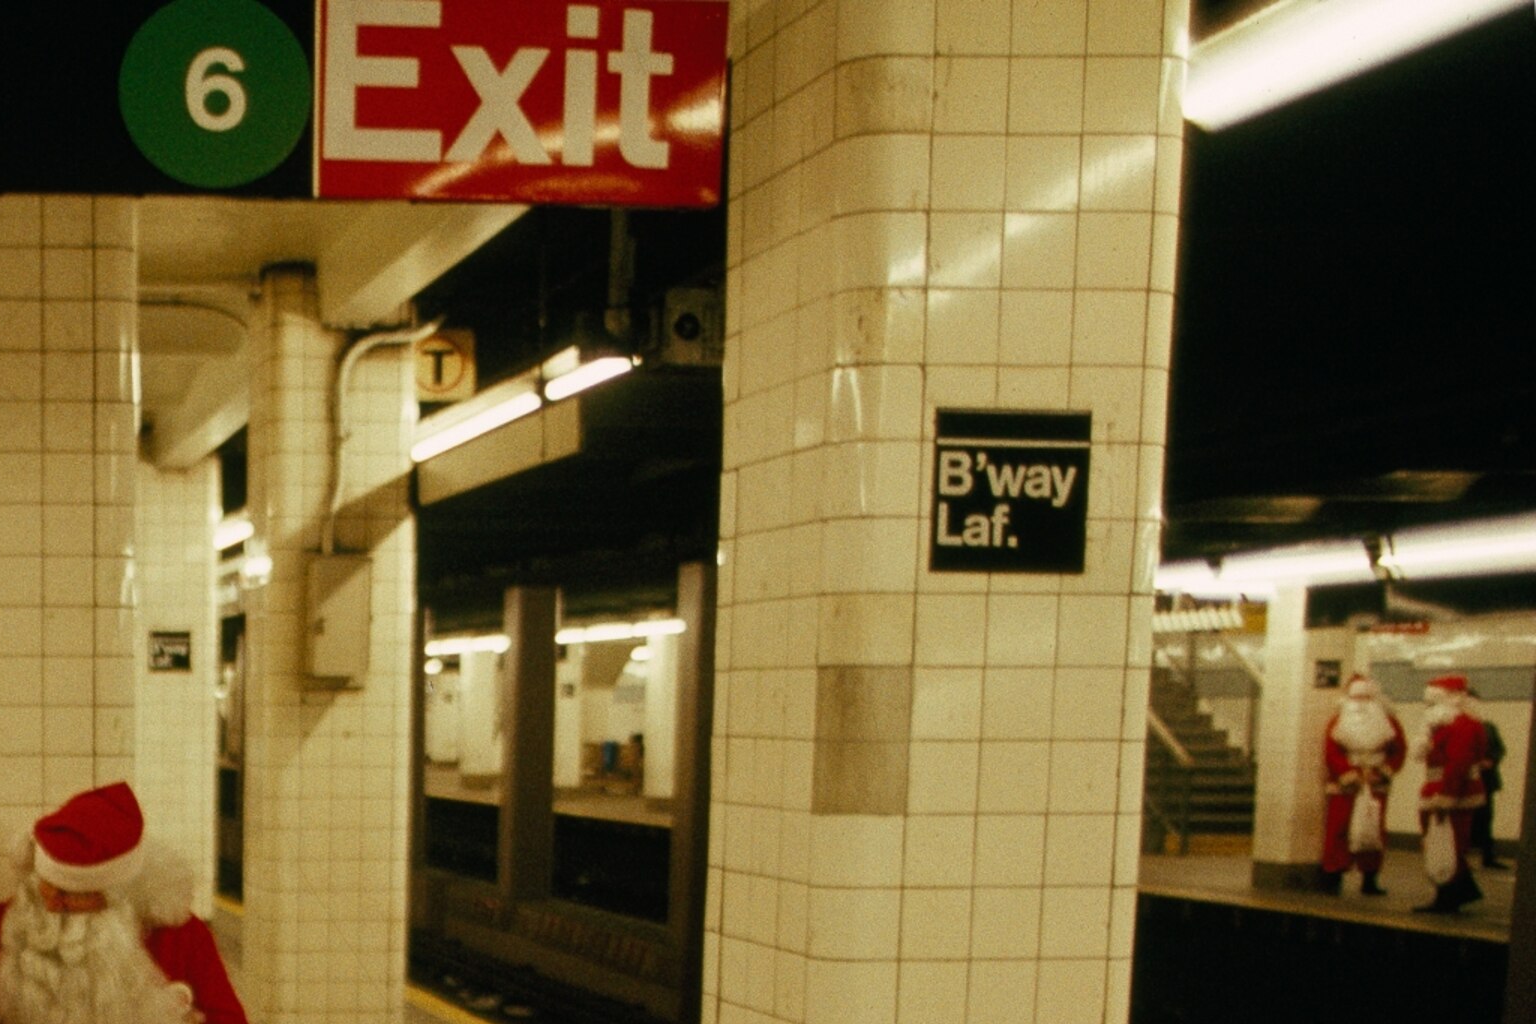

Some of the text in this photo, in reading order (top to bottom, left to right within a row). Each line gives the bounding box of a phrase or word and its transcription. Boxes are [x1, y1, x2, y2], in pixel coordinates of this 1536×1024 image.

[185, 46, 248, 132] 6
[323, 0, 674, 169] Exit
[938, 450, 1077, 508] B'way
[936, 502, 1019, 547] Laf.
